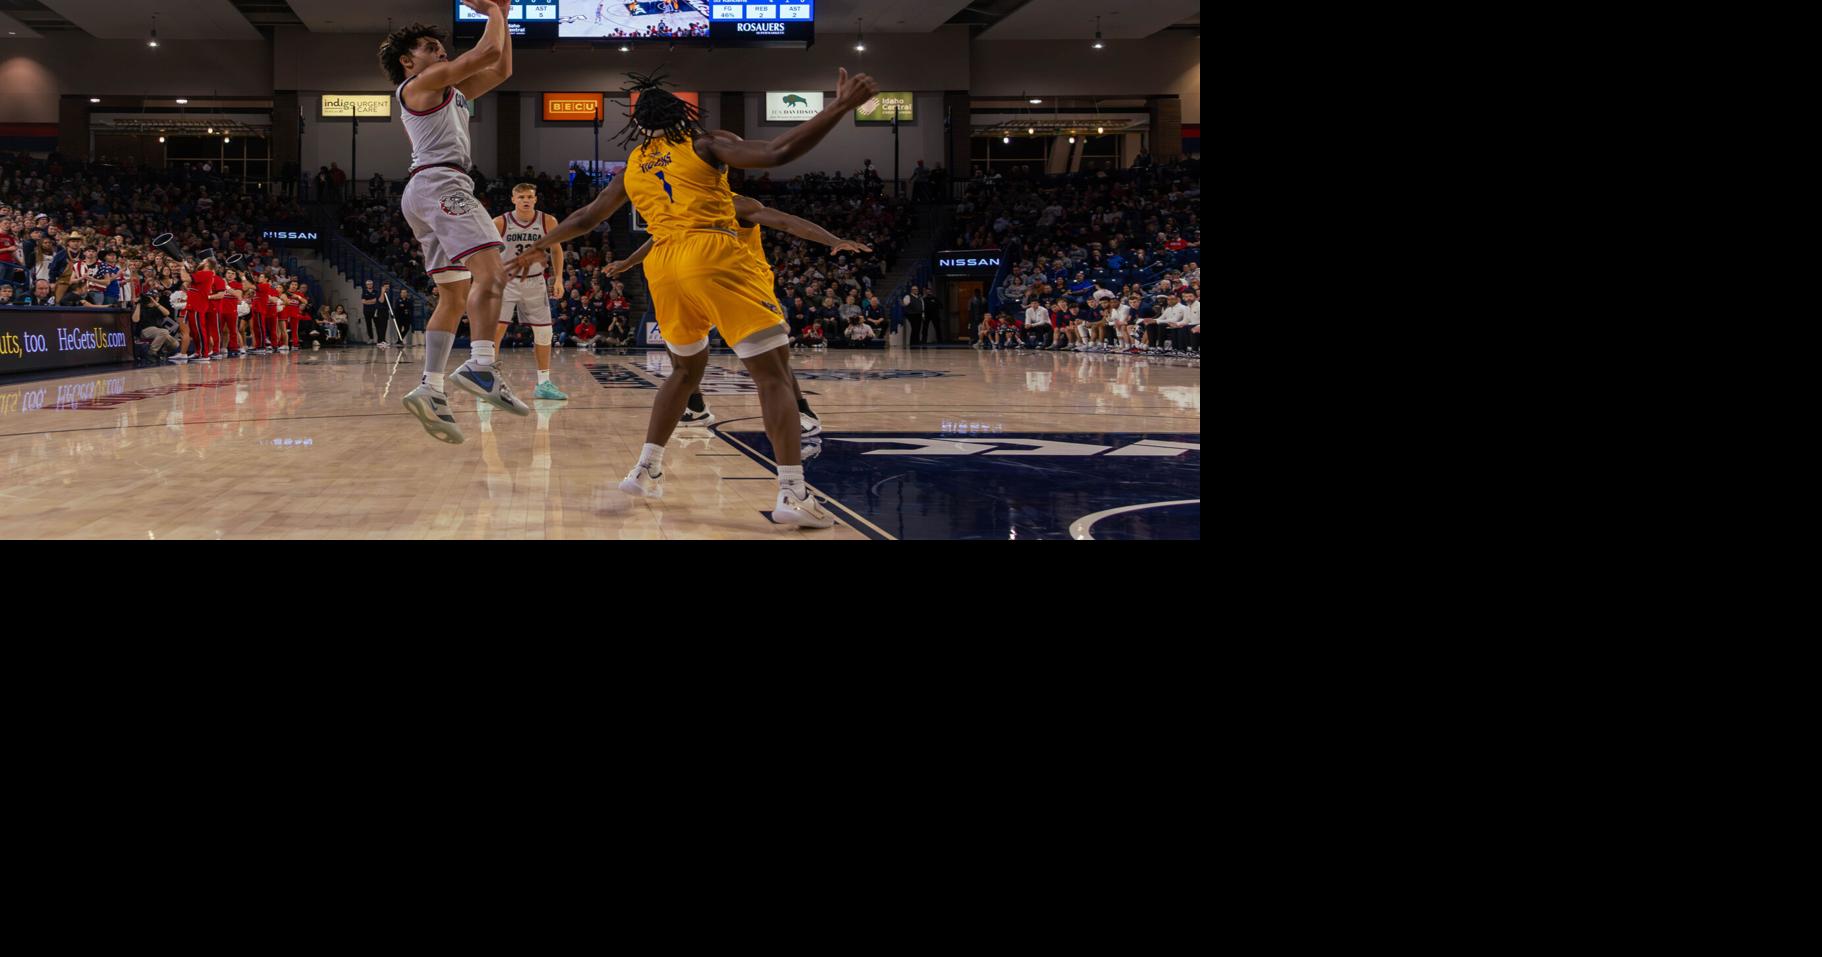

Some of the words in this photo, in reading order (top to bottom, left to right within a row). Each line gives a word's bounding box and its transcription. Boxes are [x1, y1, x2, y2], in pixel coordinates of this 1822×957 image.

[737, 23, 785, 32] ROSAUERS
[324, 98, 356, 111] indigo
[552, 103, 594, 111] BECU
[655, 170, 674, 204] 1
[263, 231, 317, 240] NISSAN
[506, 233, 542, 242] GONZAGA
[939, 258, 1000, 267] NISSAN
[23, 331, 49, 353] too.
[57, 327, 127, 351] HeGetsUs.com
